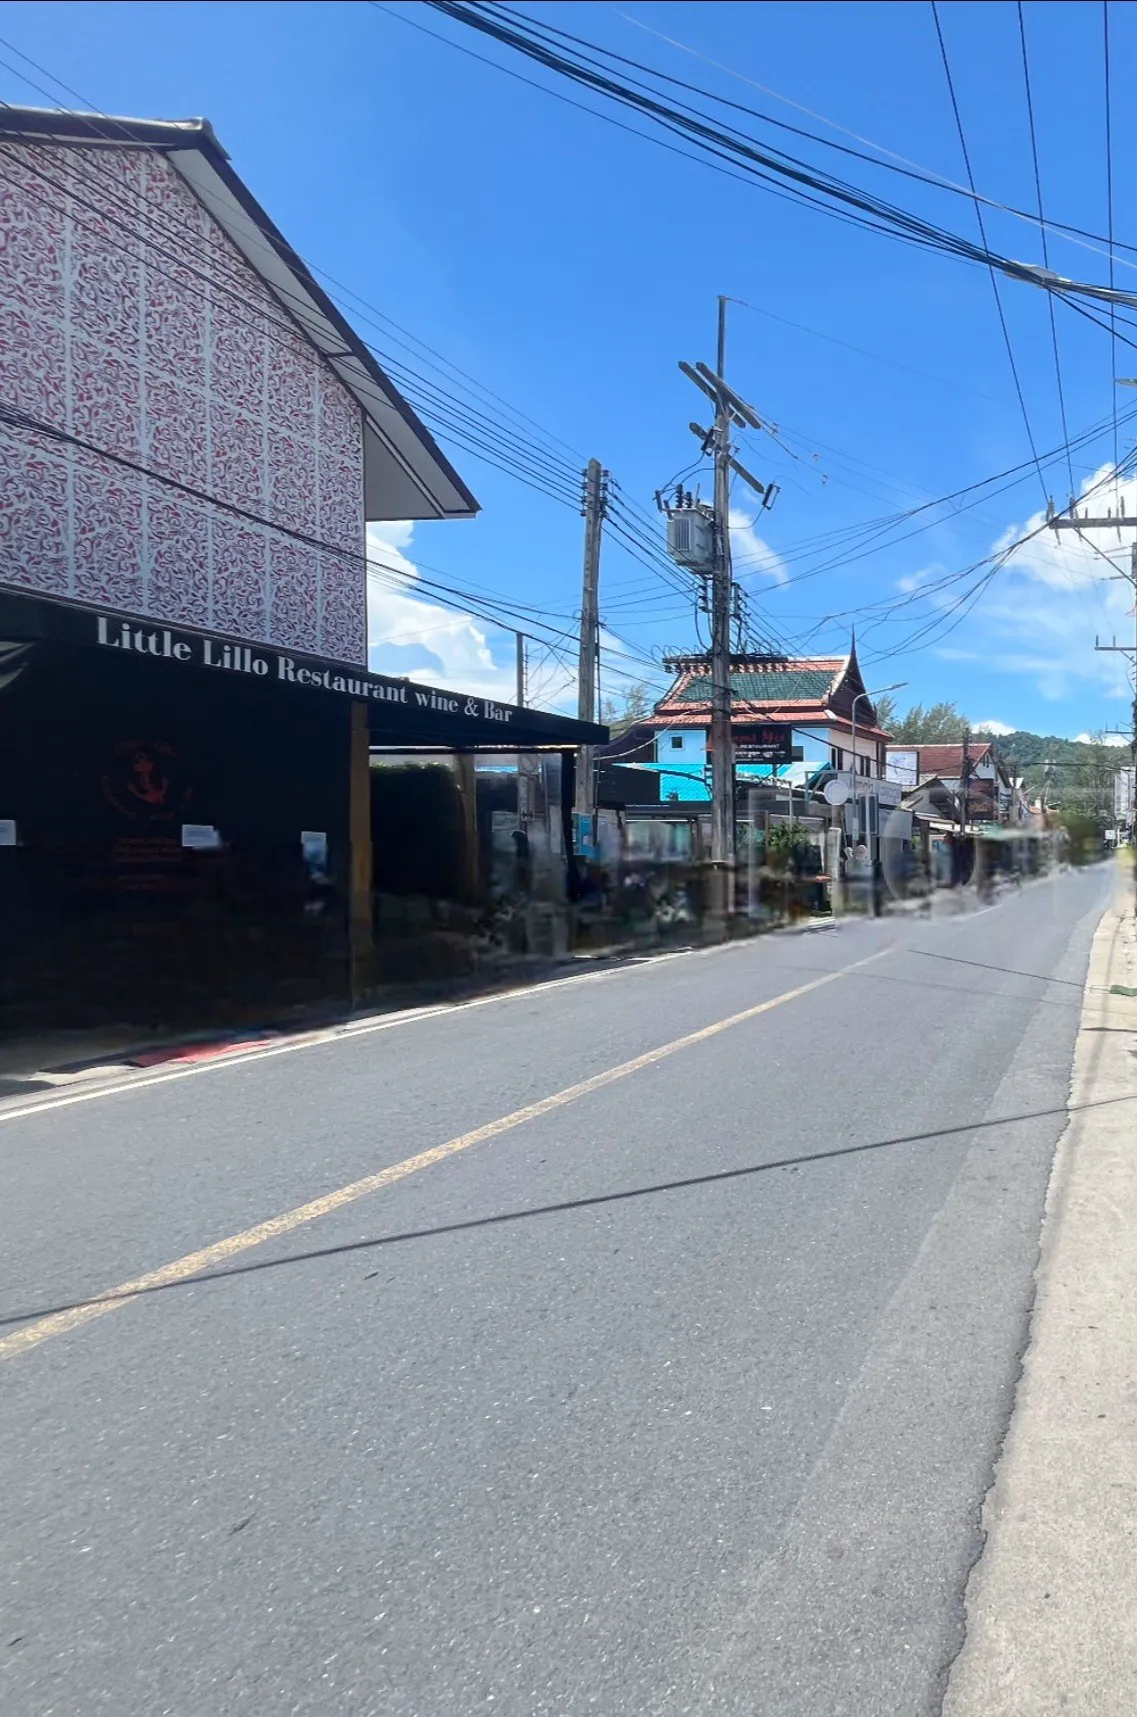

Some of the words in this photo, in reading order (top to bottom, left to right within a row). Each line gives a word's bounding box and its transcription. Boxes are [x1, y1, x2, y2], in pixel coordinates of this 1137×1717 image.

[96, 616, 192, 661] Little
[203, 639, 269, 676] Lillo
[278, 655, 408, 704] Restaurant
[414, 689, 459, 713] wine
[464, 697, 480, 717] &
[484, 699, 513, 722] Bar
